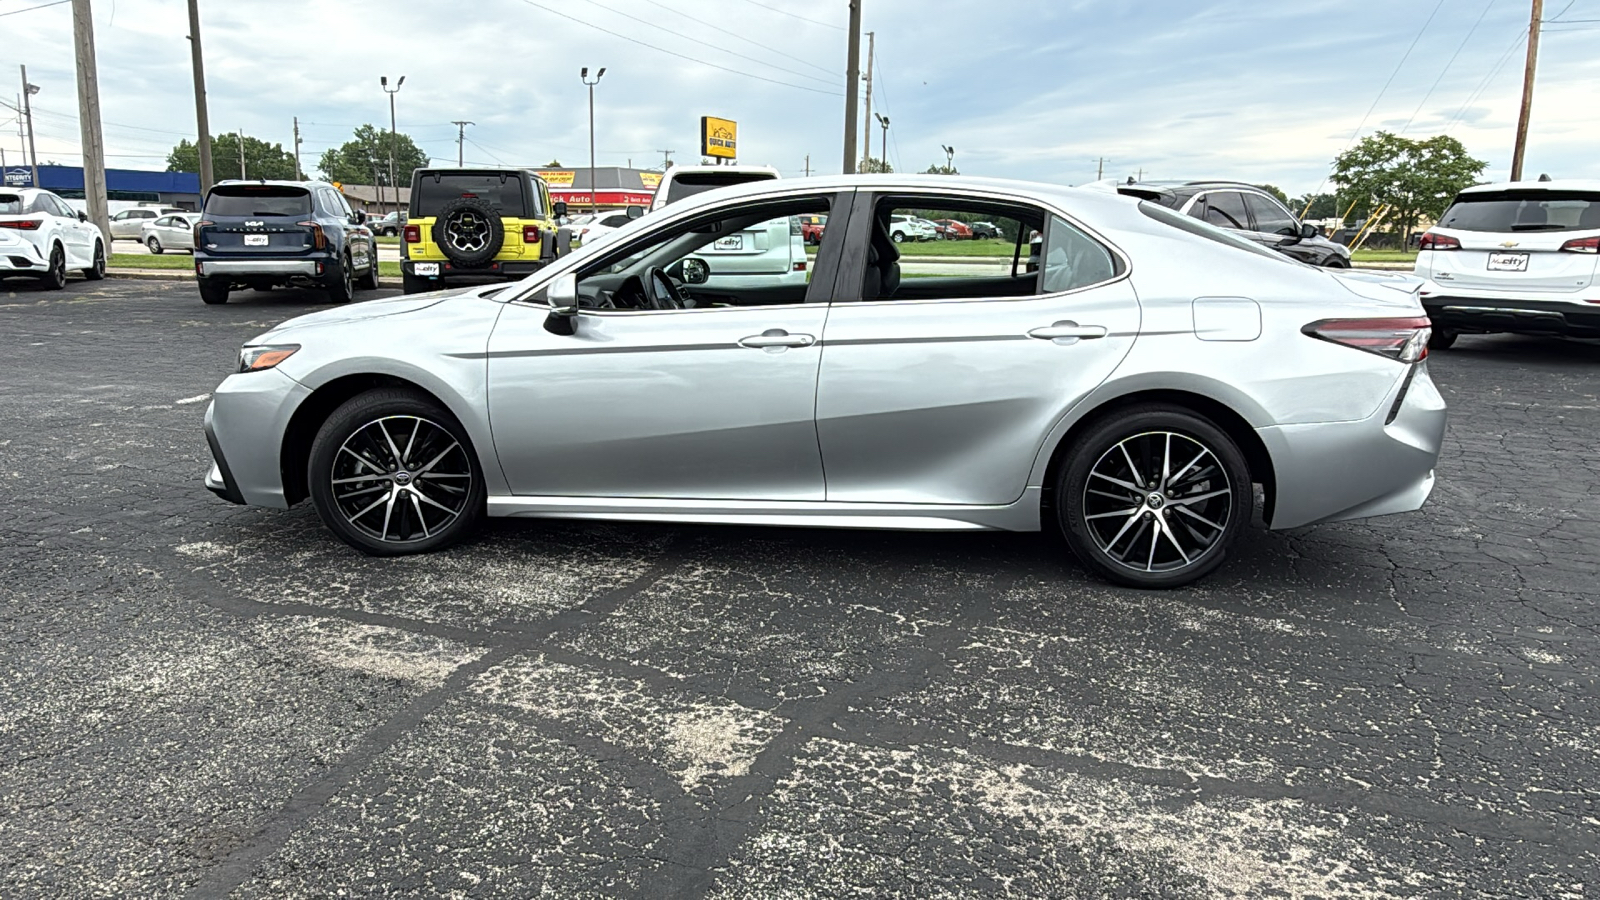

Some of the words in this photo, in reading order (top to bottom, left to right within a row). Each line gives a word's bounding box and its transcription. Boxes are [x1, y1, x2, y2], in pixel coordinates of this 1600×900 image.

[709, 138, 724, 146] QUICK
[725, 140, 736, 149] AUTO
[550, 194, 564, 202] ick
[569, 195, 591, 203] Auto
